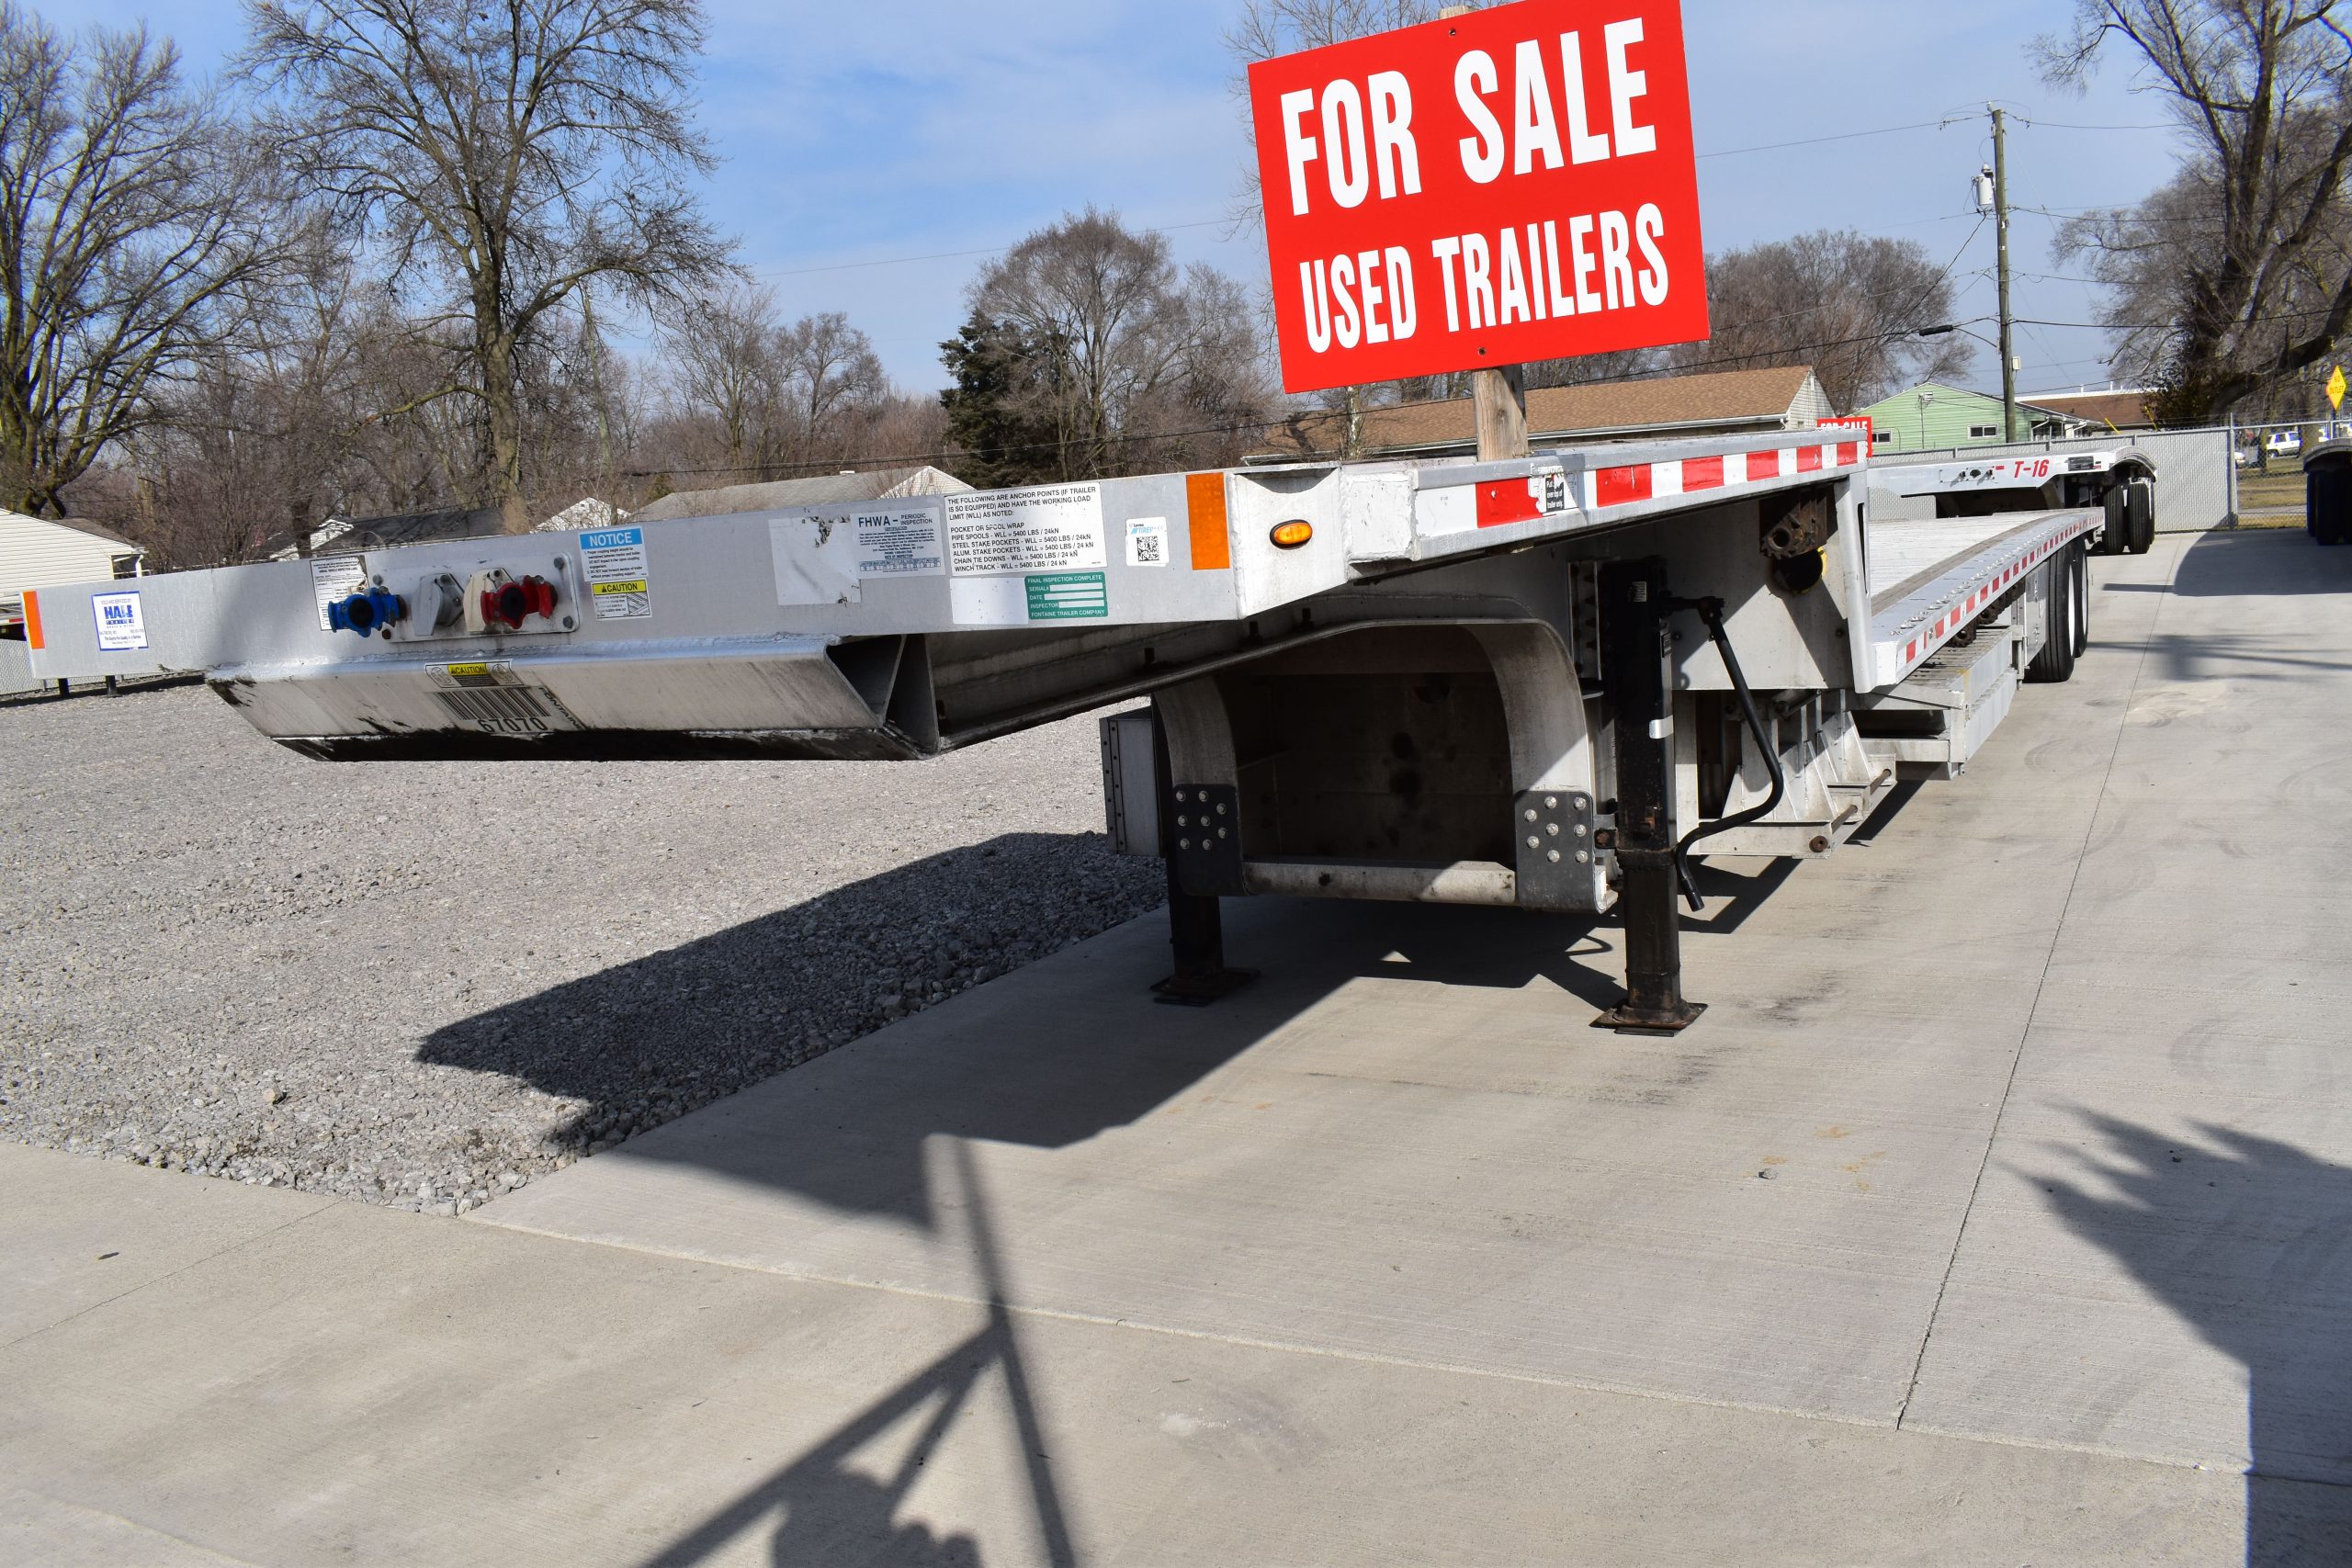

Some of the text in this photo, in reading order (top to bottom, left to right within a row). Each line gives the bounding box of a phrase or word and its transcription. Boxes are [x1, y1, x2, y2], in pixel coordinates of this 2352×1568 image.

[1281, 17, 1657, 217] FOR SALE
[1299, 202, 1670, 354] USED TRAILERS
[2329, 385, 2344, 394] OUTLET
[2014, 458, 2050, 479] T-16
[960, 496, 995, 504] FOLLOWING
[1010, 491, 1036, 500] ANCHOR
[965, 503, 997, 512] EQUIPPED)
[1042, 497, 1072, 505] WORKING
[858, 515, 891, 528] FHWA
[966, 512, 982, 520] (WLL)
[589, 531, 633, 547] NOTICE
[607, 582, 639, 592] CAUTION
[104, 605, 133, 619] HALE
[455, 665, 486, 674] CAUTION
[477, 717, 549, 734] 67070
